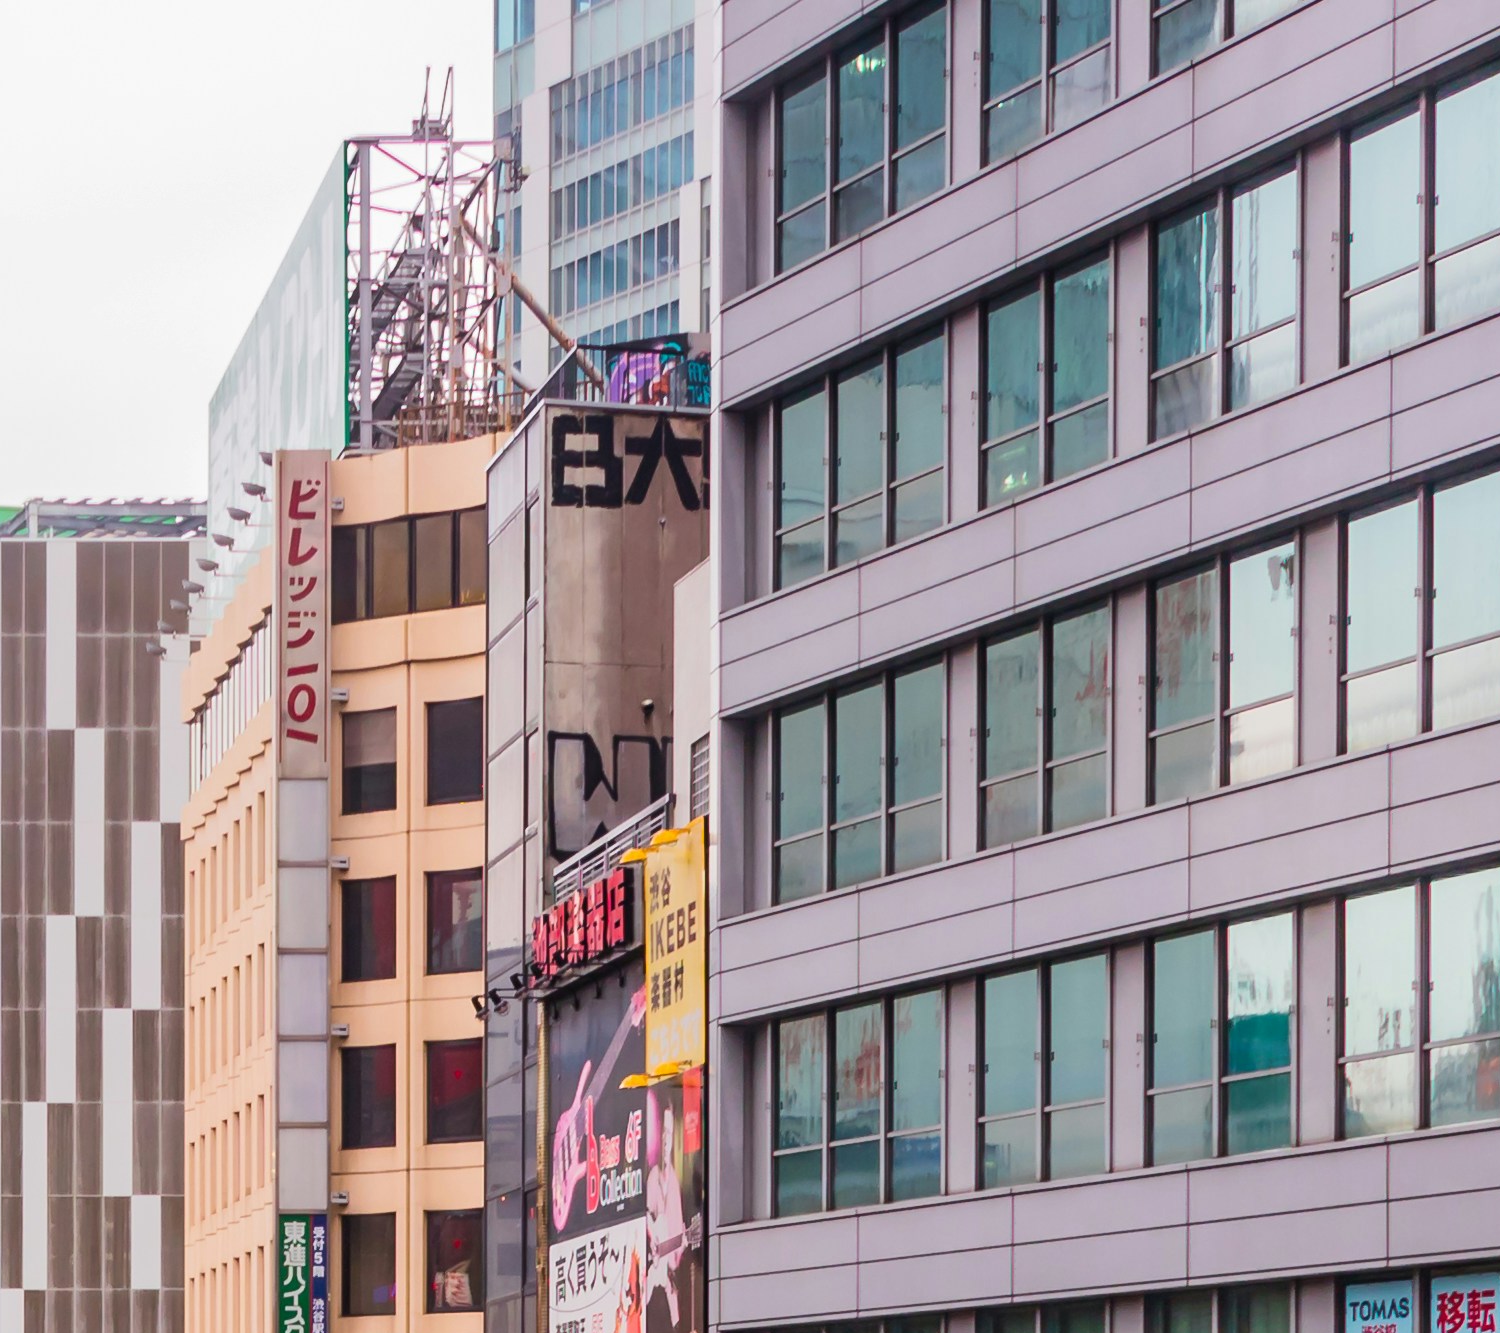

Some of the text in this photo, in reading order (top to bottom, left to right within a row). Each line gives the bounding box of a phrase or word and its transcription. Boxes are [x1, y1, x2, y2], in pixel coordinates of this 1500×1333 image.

[650, 902, 697, 964] IKEBE
[312, 1226, 325, 1278] 受付5階
[1349, 1297, 1411, 1322] TOMAS
